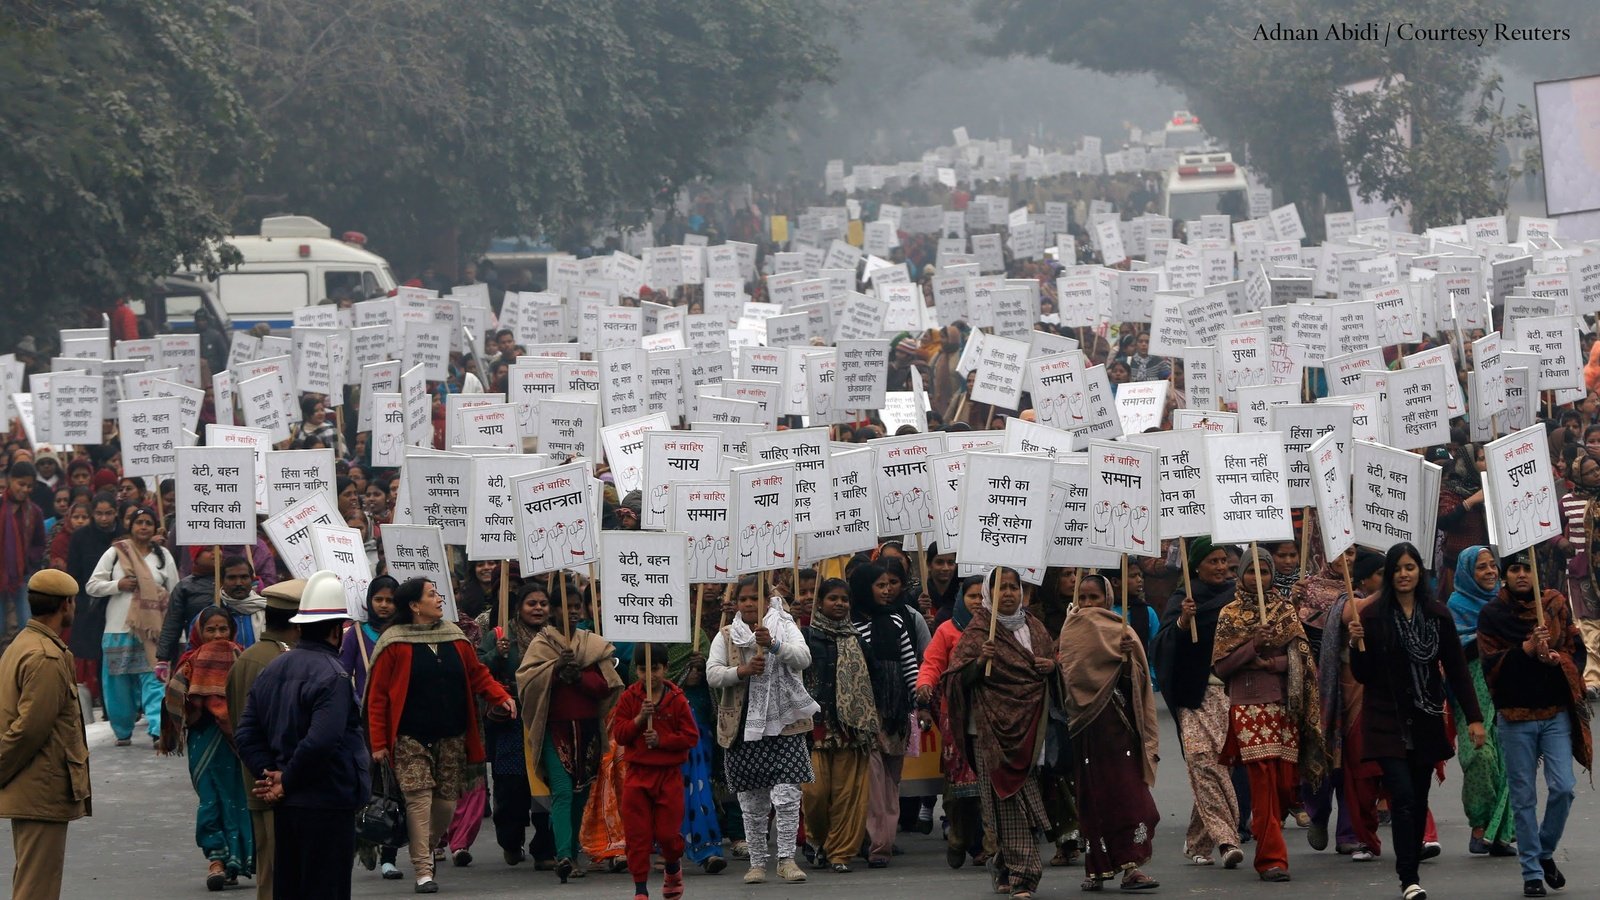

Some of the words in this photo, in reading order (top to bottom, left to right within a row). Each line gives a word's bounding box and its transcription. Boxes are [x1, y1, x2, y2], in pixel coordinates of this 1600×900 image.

[1376, 298, 1403, 310] सम्मान
[1340, 314, 1353, 322] नारी
[603, 323, 637, 331] स्वतन्त्रता
[1207, 323, 1225, 332] चाहिए
[844, 349, 862, 358] चाहिए
[865, 348, 883, 357] गरिमा
[1232, 349, 1256, 363] सुरक्षा
[751, 365, 778, 374] सम्मान
[1004, 363, 1020, 374] चाहिए
[1545, 369, 1569, 377] विधाता
[845, 373, 856, 383] नहीं
[858, 373, 876, 382] चाहिए
[1041, 373, 1073, 386] सम्मान
[372, 381, 392, 391] सम्मान
[523, 384, 555, 393] सम्मान
[569, 378, 599, 391] प्रतिष्ठा
[1403, 384, 1418, 395] नारी
[748, 389, 766, 397] चाहिए
[1122, 397, 1155, 406] समानता
[1406, 395, 1431, 406] अपमान
[474, 414, 483, 422] हमें
[486, 412, 504, 420] चाहिए
[713, 412, 728, 422] नारी
[1097, 407, 1107, 416] की
[1402, 411, 1418, 423] नहीं
[1418, 409, 1438, 419] सहेगा
[572, 418, 582, 427] की
[478, 425, 502, 435] न्याय
[559, 428, 574, 437] नारी
[133, 442, 159, 451] परिवार
[162, 440, 173, 449] की
[225, 434, 235, 442] हमें
[237, 436, 257, 445] चाहिए
[575, 442, 584, 451] की
[665, 442, 676, 450] हमें
[679, 442, 703, 452] चाहिए
[760, 446, 788, 459] चाहिए
[792, 444, 820, 456] गरिमा
[888, 448, 900, 458] हमें
[903, 446, 927, 455] चाहिए
[1504, 449, 1513, 461] हमें
[1514, 443, 1534, 455] चाहिए
[1104, 454, 1115, 463] हमें
[1117, 456, 1139, 468] चाहिए
[1172, 450, 1189, 464] नहीं
[1225, 455, 1246, 469] हिंसा
[1249, 453, 1268, 467] नहीं
[668, 458, 699, 470] न्याय
[949, 462, 960, 472] हमें
[192, 464, 213, 477] बेटी,
[217, 467, 239, 477] बहन
[281, 467, 300, 479] हिंसा
[303, 466, 319, 478] नहीं
[1172, 466, 1200, 479] चाहिए
[1216, 474, 1247, 484] सम्मान
[1250, 469, 1279, 483] चाहिए
[1367, 462, 1385, 479] बेटी,
[1389, 471, 1407, 484] बहन
[1506, 460, 1536, 487] सुरक्षा
[426, 473, 444, 484] नारी
[752, 478, 761, 488] हमें
[763, 475, 782, 485] चाहिए
[841, 471, 858, 485] नहीं
[988, 476, 1011, 489] नारी
[1015, 481, 1030, 491] का
[1101, 471, 1141, 489] सम्मान
[194, 484, 211, 495] बहू,
[216, 484, 237, 492] माता
[273, 483, 300, 491] सम्मान
[303, 479, 328, 490] चाहिए
[532, 482, 544, 493] हमें
[547, 478, 570, 489] चाहिए
[428, 489, 459, 497] अपमान
[689, 491, 700, 501] हमें
[703, 491, 725, 501] चाहिए
[841, 485, 867, 498] चाहिए
[1368, 483, 1383, 498] बहू,
[1387, 488, 1406, 501] माता
[524, 489, 582, 514] स्वतन्त्रता
[754, 493, 779, 507] न्याय
[988, 494, 1027, 506] अपमान
[1230, 492, 1257, 505] जीवन
[1260, 494, 1273, 503] का
[191, 501, 224, 513] परिवार
[228, 501, 241, 513] की
[424, 503, 440, 515] नहीं
[443, 504, 467, 515] सहेगा
[849, 508, 860, 517] का
[1223, 511, 1251, 520] आधार
[1255, 505, 1283, 519] चाहिए
[1365, 502, 1394, 519] परिवार
[1397, 510, 1408, 523] की
[283, 516, 295, 528] हमें
[296, 505, 317, 520] चाहिए
[485, 513, 514, 525] परिवार
[687, 509, 727, 521] सम्मान
[979, 512, 1000, 527] नहीं
[1002, 514, 1032, 529] सहेगा
[187, 521, 210, 529] भाग्य
[213, 517, 245, 529] विधाता
[1362, 520, 1382, 533] भाग्य
[1384, 523, 1412, 541] विधाता
[1054, 537, 1083, 546] आधार
[333, 551, 354, 564] न्याय
[396, 545, 414, 557] हिंसा
[416, 545, 429, 558] नहीं
[619, 551, 641, 566] बेटी,
[647, 556, 670, 566] बहन
[392, 561, 415, 570] सम्मान
[418, 559, 439, 572] चाहिए
[621, 574, 639, 587] बहू,
[645, 574, 668, 584] माता
[618, 593, 654, 606] परिवार
[658, 593, 672, 607] की
[614, 615, 639, 624] भाग्य
[643, 612, 678, 625] विधाता
